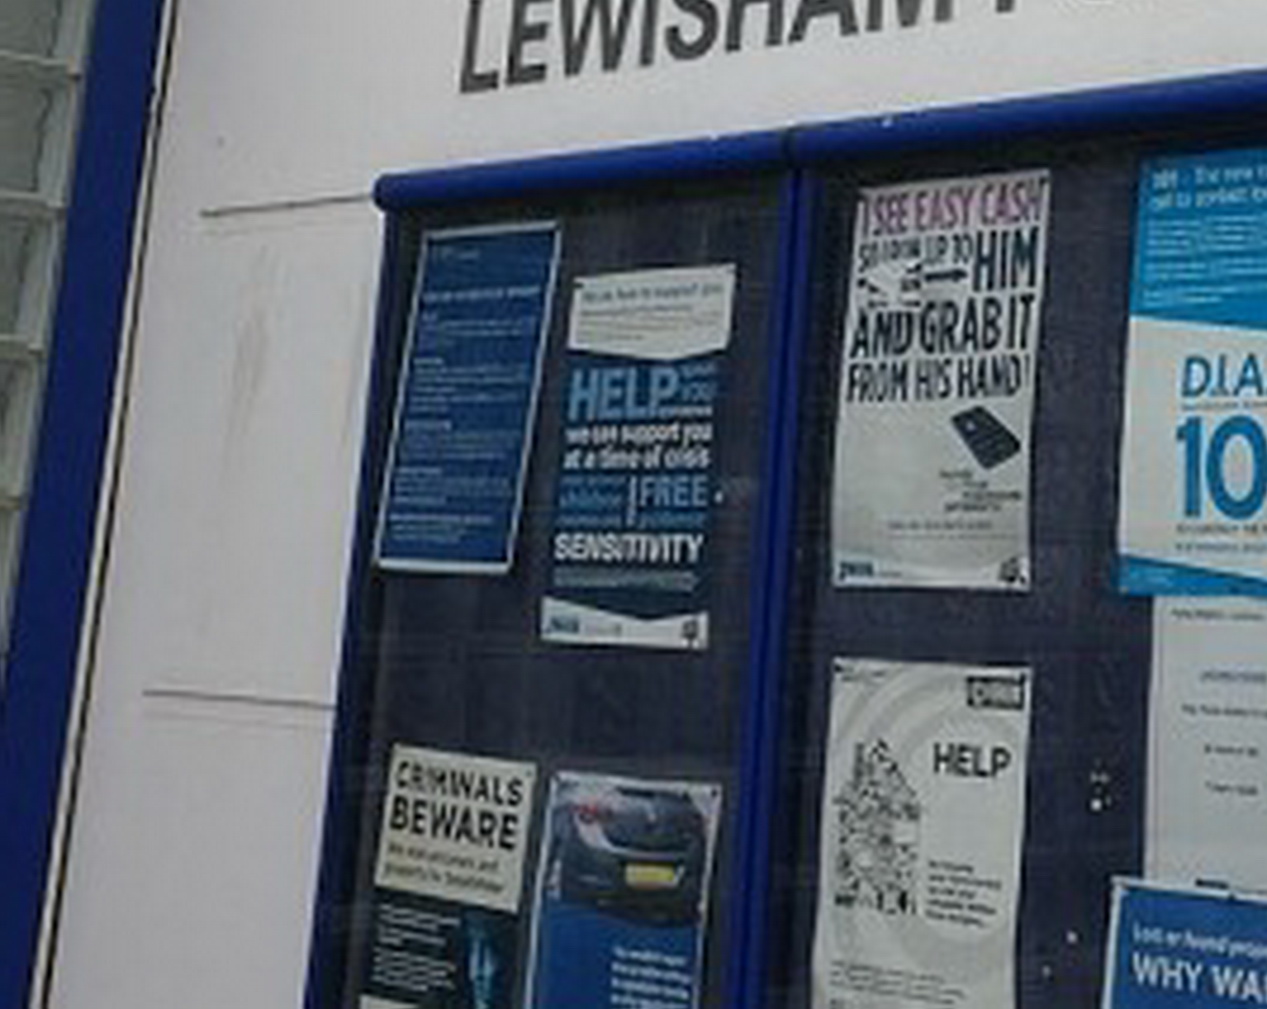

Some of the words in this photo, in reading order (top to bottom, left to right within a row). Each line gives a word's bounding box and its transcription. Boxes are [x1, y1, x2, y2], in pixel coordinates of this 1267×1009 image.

[873, 191, 909, 236] SEE
[915, 187, 975, 232] EASY
[980, 177, 1042, 226] CASH
[973, 226, 1039, 292] HIM
[850, 305, 913, 359] AND
[920, 296, 1002, 354] GRAB
[1007, 291, 1036, 351] IT
[567, 365, 680, 422] HELP
[846, 361, 907, 403] FROM
[915, 357, 951, 400] HIS
[639, 474, 708, 508] FREE
[554, 532, 704, 564] SENSITIVITY
[933, 742, 1011, 779] HELP
[397, 761, 523, 807] CRIMINALS
[389, 793, 518, 852] BEWARE
[1132, 951, 1202, 993] WHY
